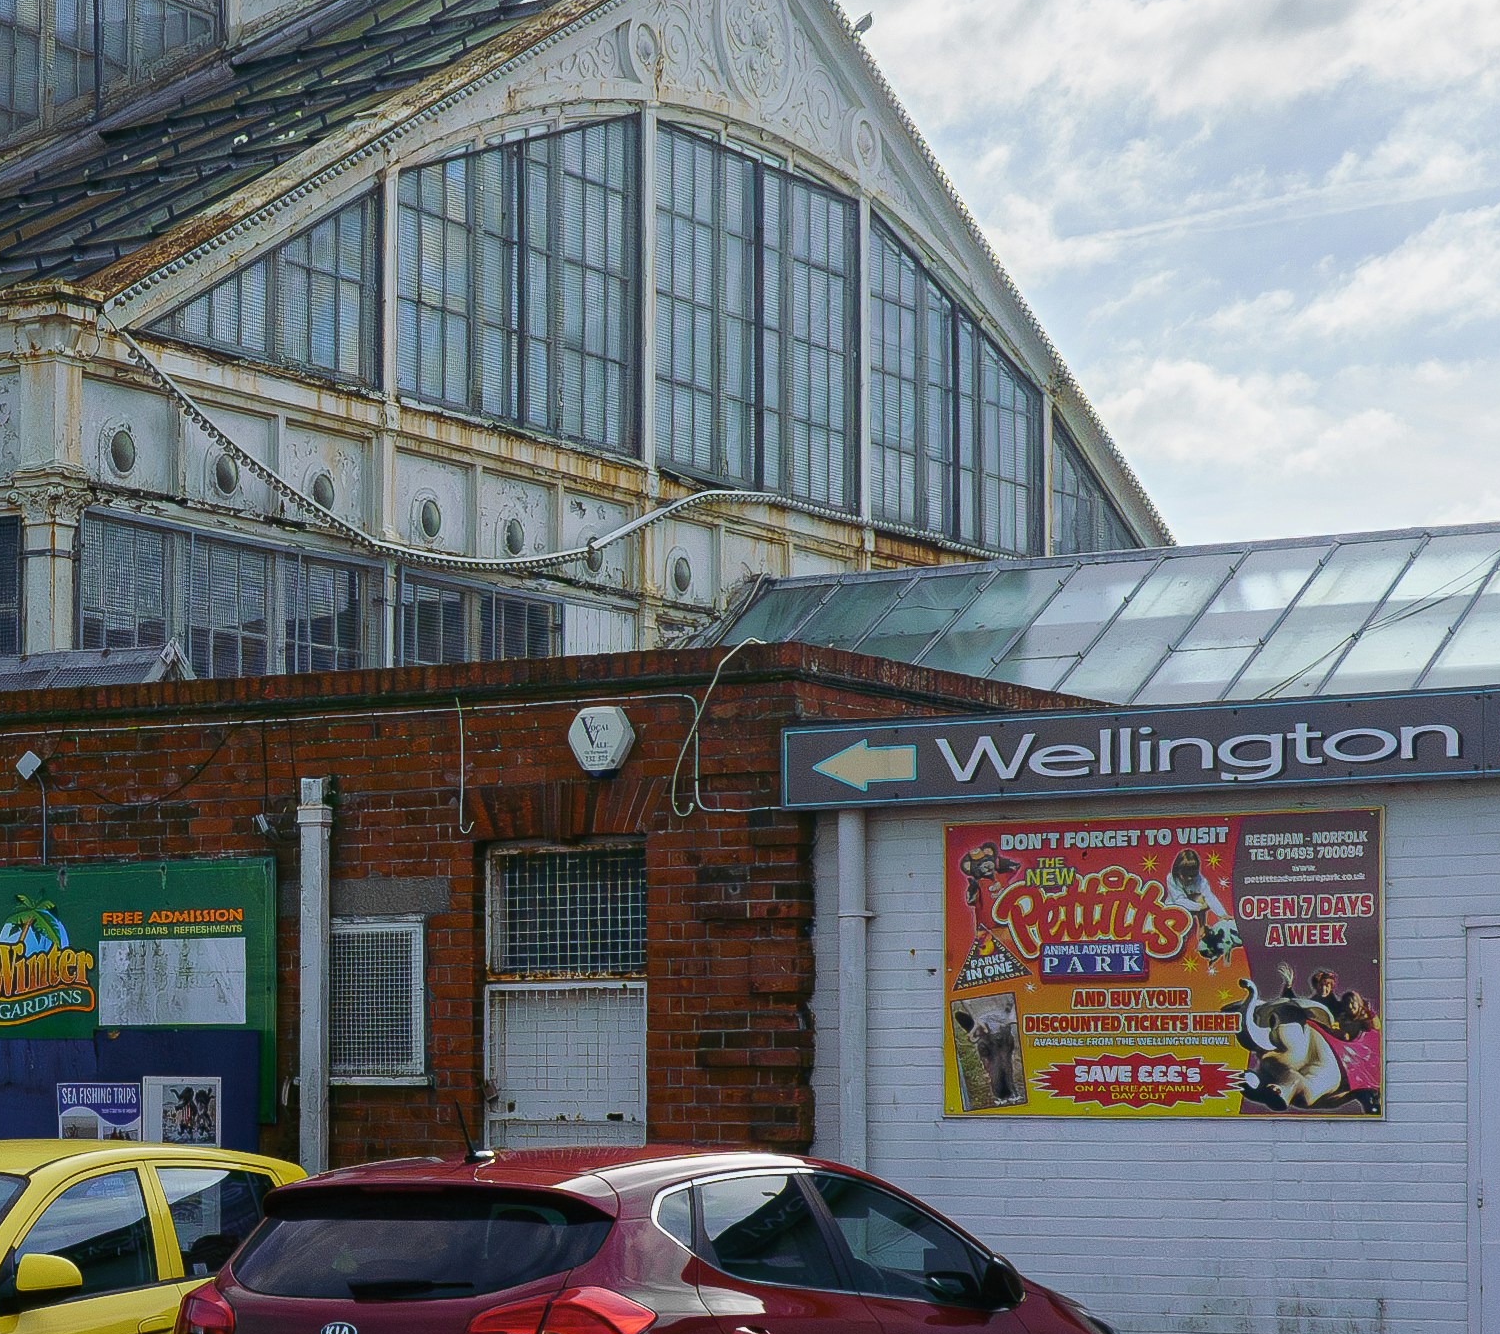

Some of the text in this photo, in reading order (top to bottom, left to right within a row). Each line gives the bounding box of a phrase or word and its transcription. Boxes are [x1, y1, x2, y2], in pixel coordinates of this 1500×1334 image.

[935, 723, 1462, 782] Wellington
[1001, 826, 1229, 850] DON'T FORGET TO VISIT
[1245, 833, 1303, 846] REEDHAM
[1312, 830, 1368, 844] NORFOLK
[1037, 857, 1065, 868] THE
[1249, 848, 1274, 861] TEL:
[1025, 867, 1075, 887] NEW
[994, 867, 1191, 958] Pettitts
[1239, 893, 1374, 920] OPEN 7 DAYS
[102, 908, 243, 925] FREE ADMISSION
[145, 926, 169, 936] BARS
[173, 924, 243, 935] REFRESHMENTS
[1265, 923, 1347, 947] A WEEK
[1043, 943, 1140, 955] ANIMAL ADVENTURE
[970, 953, 1006, 968] PARKS
[1043, 955, 1141, 973] PARK
[966, 961, 1013, 981] IN ONE
[1072, 988, 1191, 1009] AND BUY YOUR
[1024, 1013, 1242, 1034] DISCOUNTED TICKETS HERE!
[1033, 1037, 1230, 1047] AVAILABLE FROM THE WELLINGTON BOWL
[1075, 1066, 1132, 1083] SAVE
[61, 1087, 137, 1104] SEA FISHING TRIPS
[1111, 1092, 1167, 1100] DAY OUT
